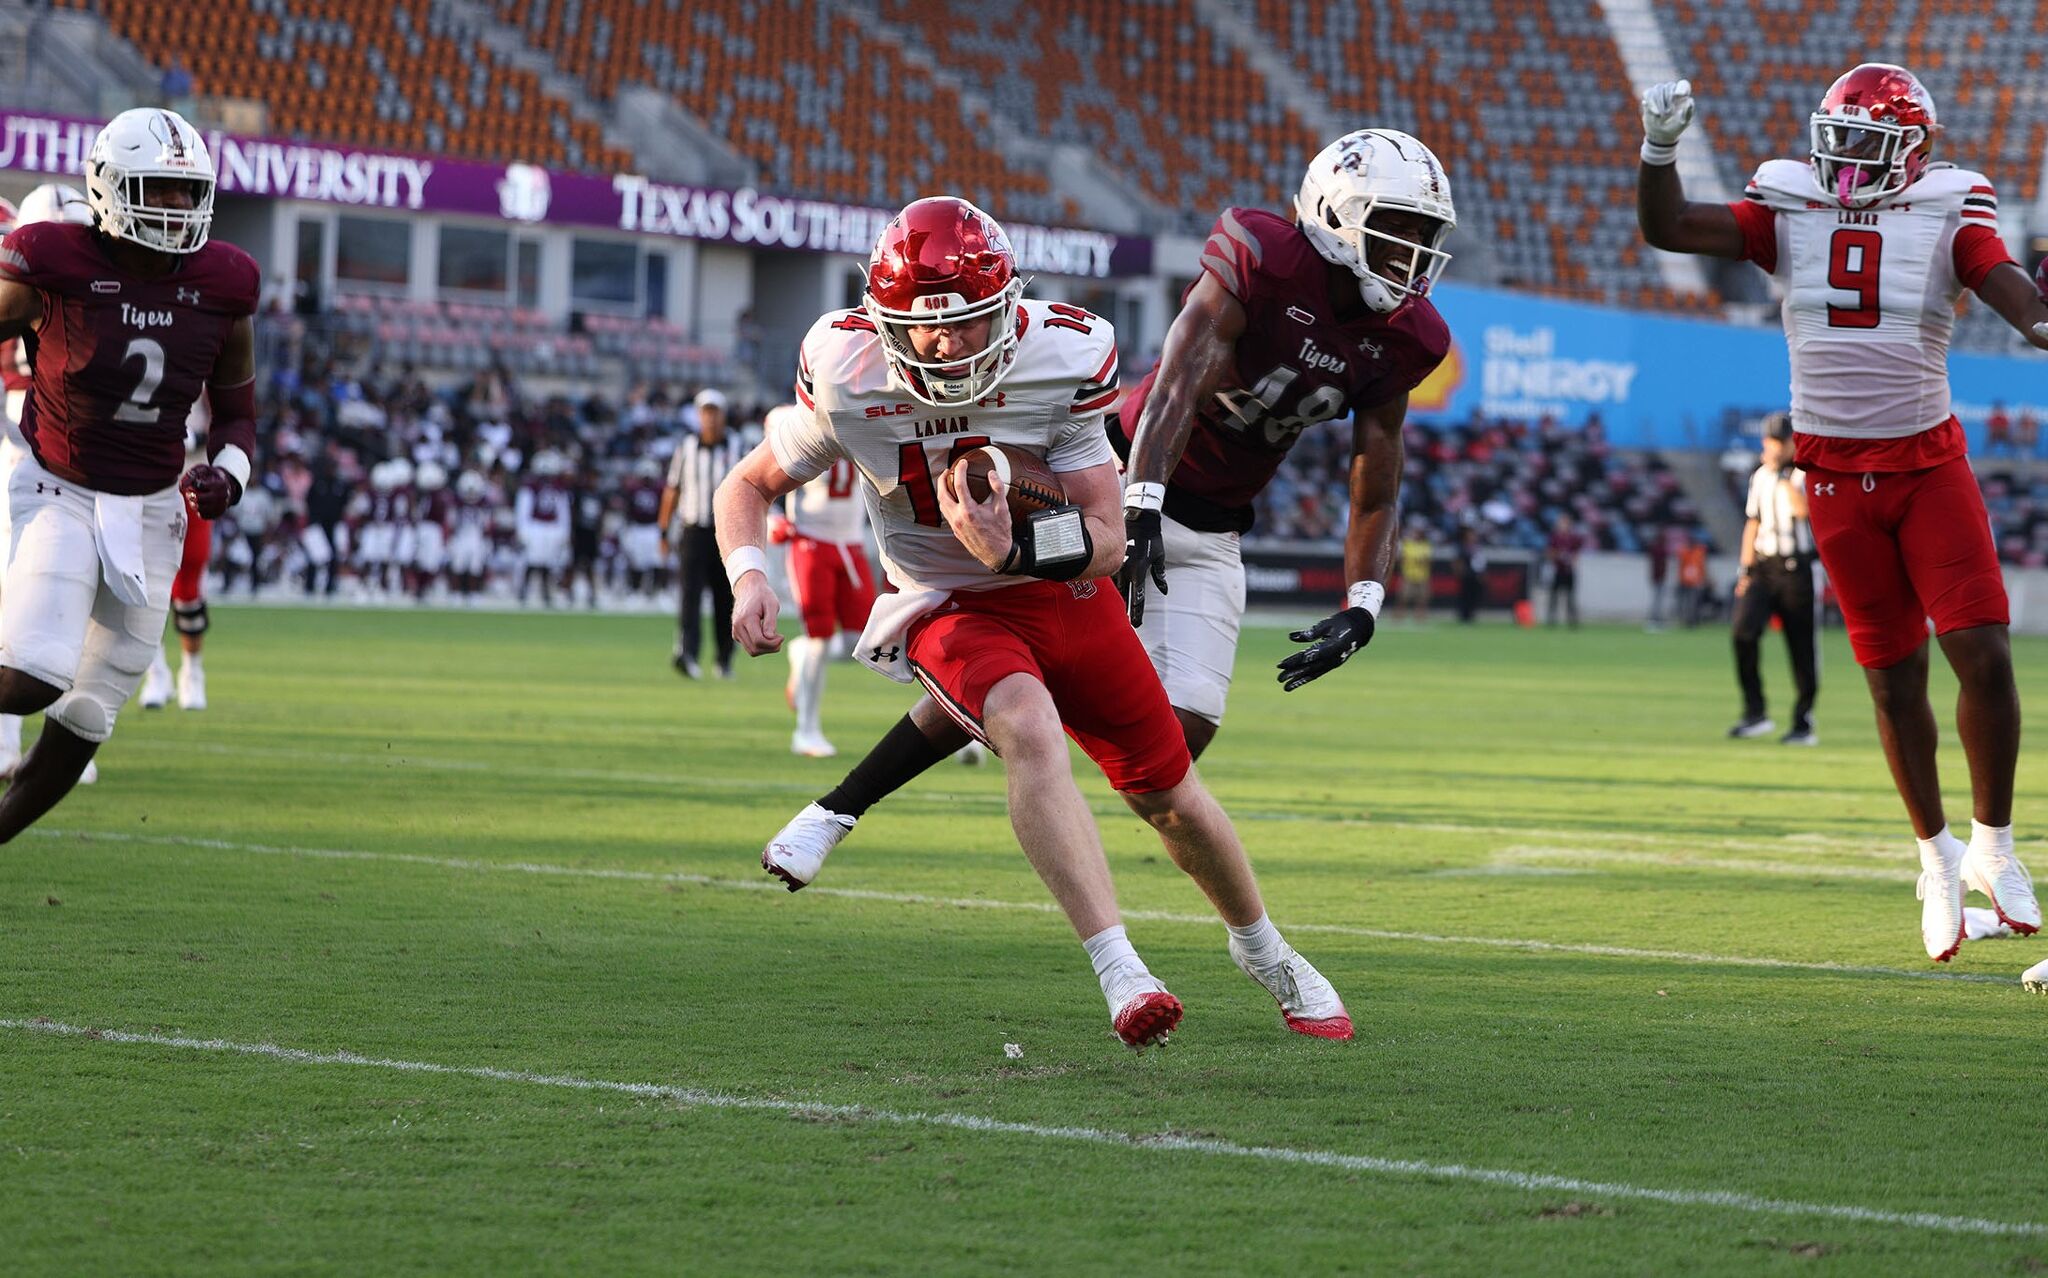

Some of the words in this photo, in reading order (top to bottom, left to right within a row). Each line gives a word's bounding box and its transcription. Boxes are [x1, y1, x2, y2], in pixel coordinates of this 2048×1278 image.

[1837, 211, 1879, 226] LAMAR
[1826, 228, 1883, 329] 9
[121, 302, 173, 330] Tigers
[1298, 337, 1347, 374] Tigers
[112, 337, 166, 423] 2
[864, 403, 914, 419] SLC
[914, 416, 970, 438] LAMAR
